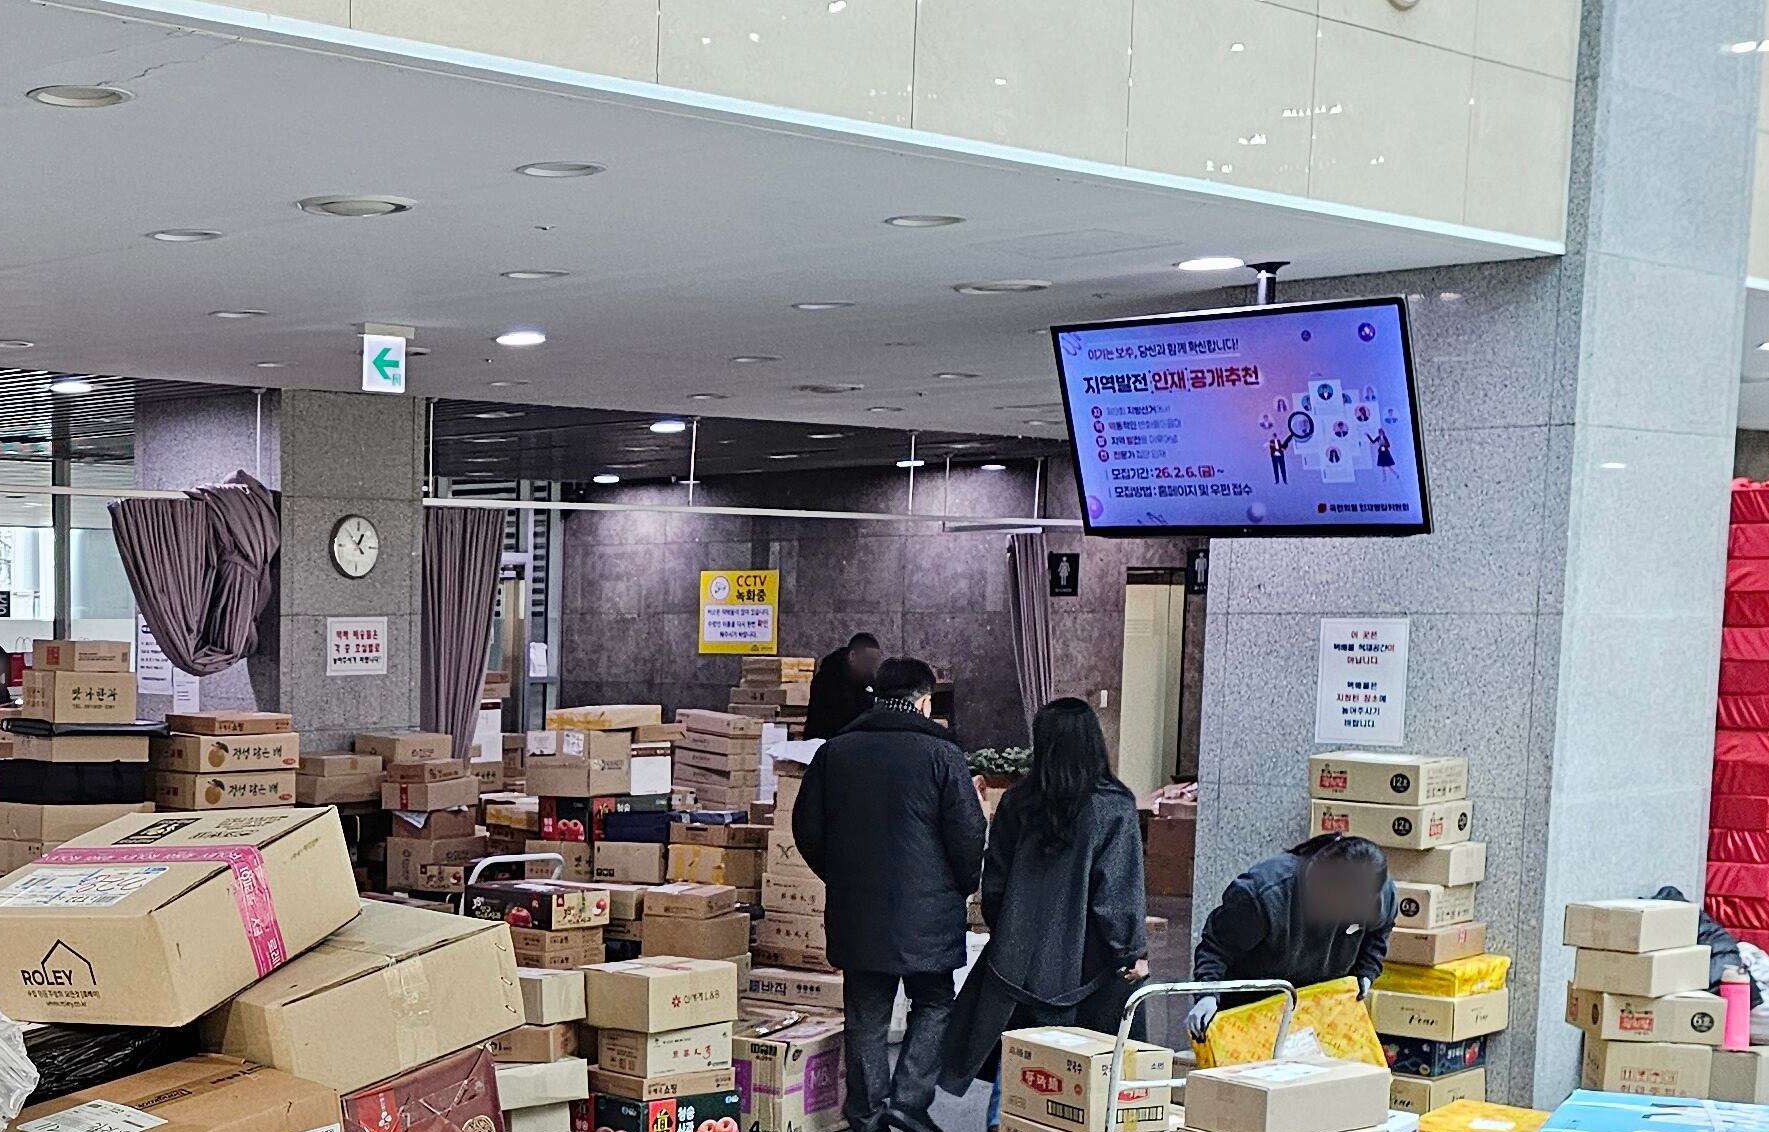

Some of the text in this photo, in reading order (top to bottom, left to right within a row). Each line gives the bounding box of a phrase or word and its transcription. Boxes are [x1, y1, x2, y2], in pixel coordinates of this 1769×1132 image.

[1137, 344, 1167, 359] 당신과
[1082, 364, 1260, 395] 지역발전 인재 공개추천
[1197, 464, 1216, 479] (금)
[1157, 482, 1253, 498] 홈페이지 및 우편 접수
[735, 574, 768, 588] CCTV
[735, 587, 767, 603] 녹화중
[1350, 630, 1359, 640] 이
[231, 744, 283, 761] 정성 담은 배
[227, 782, 280, 797] 정성 담은 배
[19, 969, 73, 987] ROLEY
[1150, 1061, 1165, 1071] 소면
[677, 1105, 696, 1122] 청송
